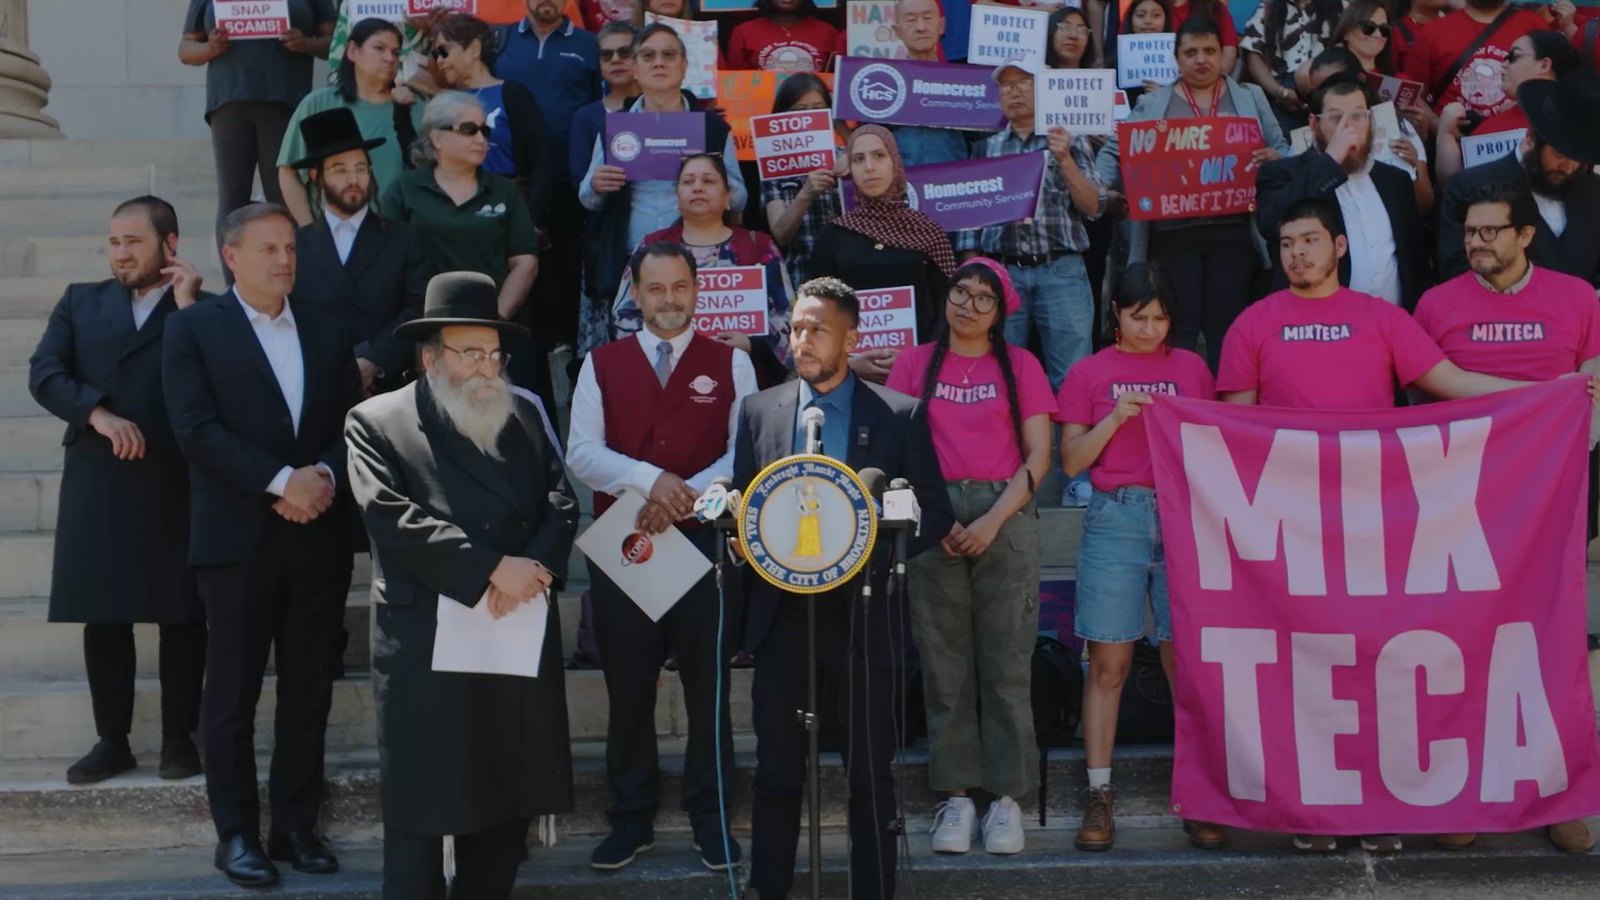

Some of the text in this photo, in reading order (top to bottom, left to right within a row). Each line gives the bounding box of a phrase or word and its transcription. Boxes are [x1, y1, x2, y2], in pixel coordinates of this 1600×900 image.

[231, 3, 271, 15] SNAP
[851, 4, 898, 25] HAN
[224, 20, 281, 35] SCAMS!
[983, 13, 1036, 30] PROTECT
[997, 30, 1020, 44] OUR
[1129, 40, 1174, 51] PROTEC
[1143, 53, 1166, 64] OUR
[912, 79, 987, 98] Homecrest
[1047, 77, 1104, 91] PROTECT
[919, 97, 973, 110] Community
[1063, 95, 1089, 108] OUR
[768, 116, 813, 133] STOP
[1044, 111, 1106, 126] BENEFITS!
[772, 135, 815, 152] SNAP
[1129, 128, 1157, 157] NO
[1225, 122, 1261, 144] CUTS
[1476, 138, 1520, 156] PROTE
[766, 153, 826, 173] SCAMS!
[923, 177, 1004, 199] Homecrest
[935, 195, 992, 213] Community
[994, 190, 1035, 205] Services
[697, 273, 743, 289] STOP
[696, 294, 744, 310] SNAP
[857, 294, 893, 310] TOP
[859, 313, 894, 329] NAP
[856, 331, 906, 349] AMS!
[1283, 324, 1351, 341] MIXTECA
[1471, 323, 1544, 341] MIXTECA
[935, 382, 997, 403] MIXTECA
[1180, 415, 1502, 596] MIX
[745, 506, 870, 586] SEAL OF THE CITY OF BROOKLYN
[1200, 621, 1568, 806] TECA
